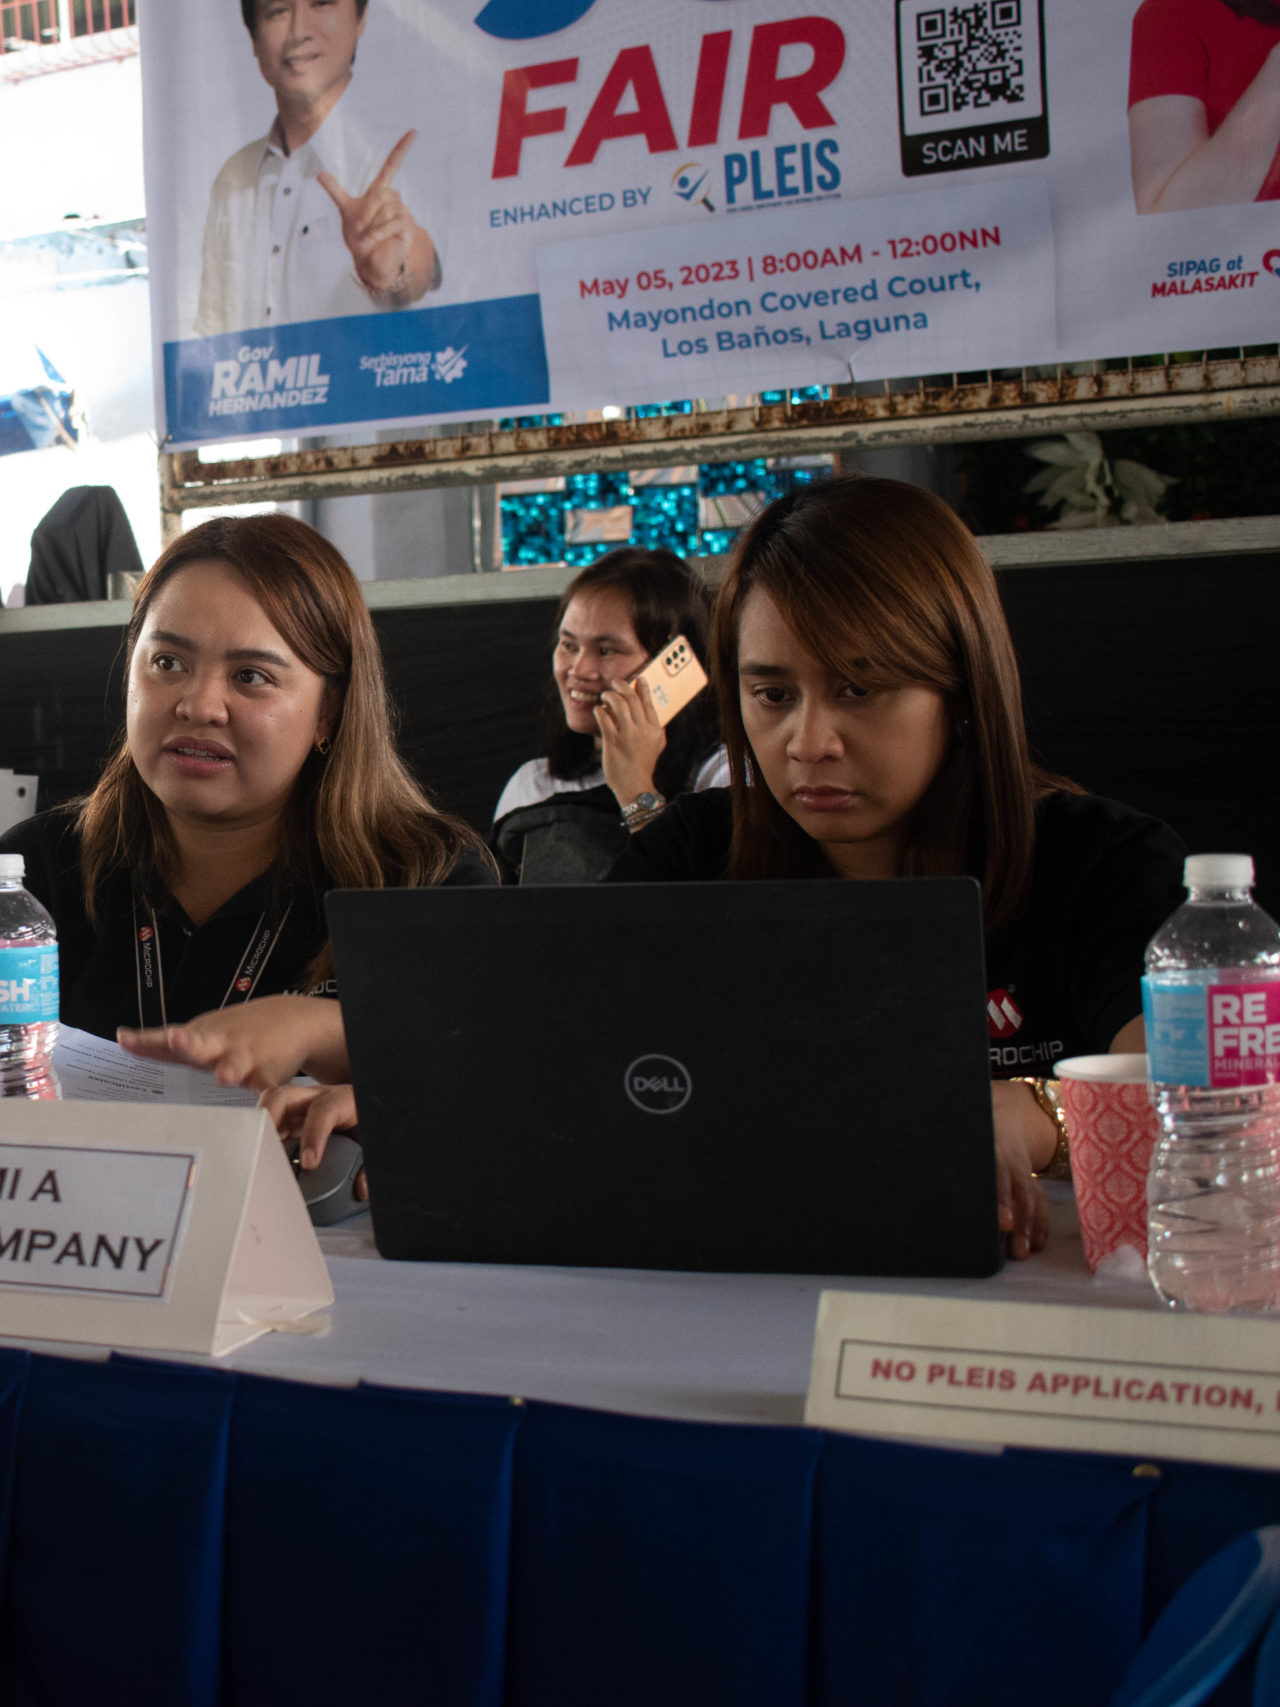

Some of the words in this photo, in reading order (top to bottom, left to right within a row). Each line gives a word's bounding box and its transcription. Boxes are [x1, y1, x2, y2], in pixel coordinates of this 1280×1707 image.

[492, 16, 846, 180] FAIR
[922, 135, 987, 164] SCAN
[993, 130, 1028, 156] ME
[724, 138, 841, 204] PLEIS
[490, 193, 615, 228] ENHANCED
[622, 186, 652, 208] BY
[579, 278, 629, 299] May
[636, 269, 673, 291] 05,
[679, 259, 740, 286] 2023
[762, 244, 863, 276] 8:00AM
[887, 226, 1001, 260] 12:00NN
[1167, 257, 1221, 278] SIPAG
[1226, 255, 1243, 271] at
[607, 298, 752, 332] Mayondon
[760, 279, 879, 313] Covered
[887, 269, 981, 298] Court,
[1151, 271, 1259, 298] MALASAKIT
[238, 346, 273, 363] Gov
[661, 336, 709, 359] Los
[717, 325, 812, 351] Baños,
[819, 312, 929, 341] Laguna
[211, 353, 330, 398] RAMIL
[374, 364, 429, 387] Tama
[209, 387, 328, 417] HERNANDEZ
[1213, 992, 1267, 1025] RE
[28, 1169, 63, 1203] A
[870, 1357, 916, 1384] NO
[927, 1363, 1017, 1391] PLEIS
[1027, 1370, 1263, 1415] APPLICATION,
